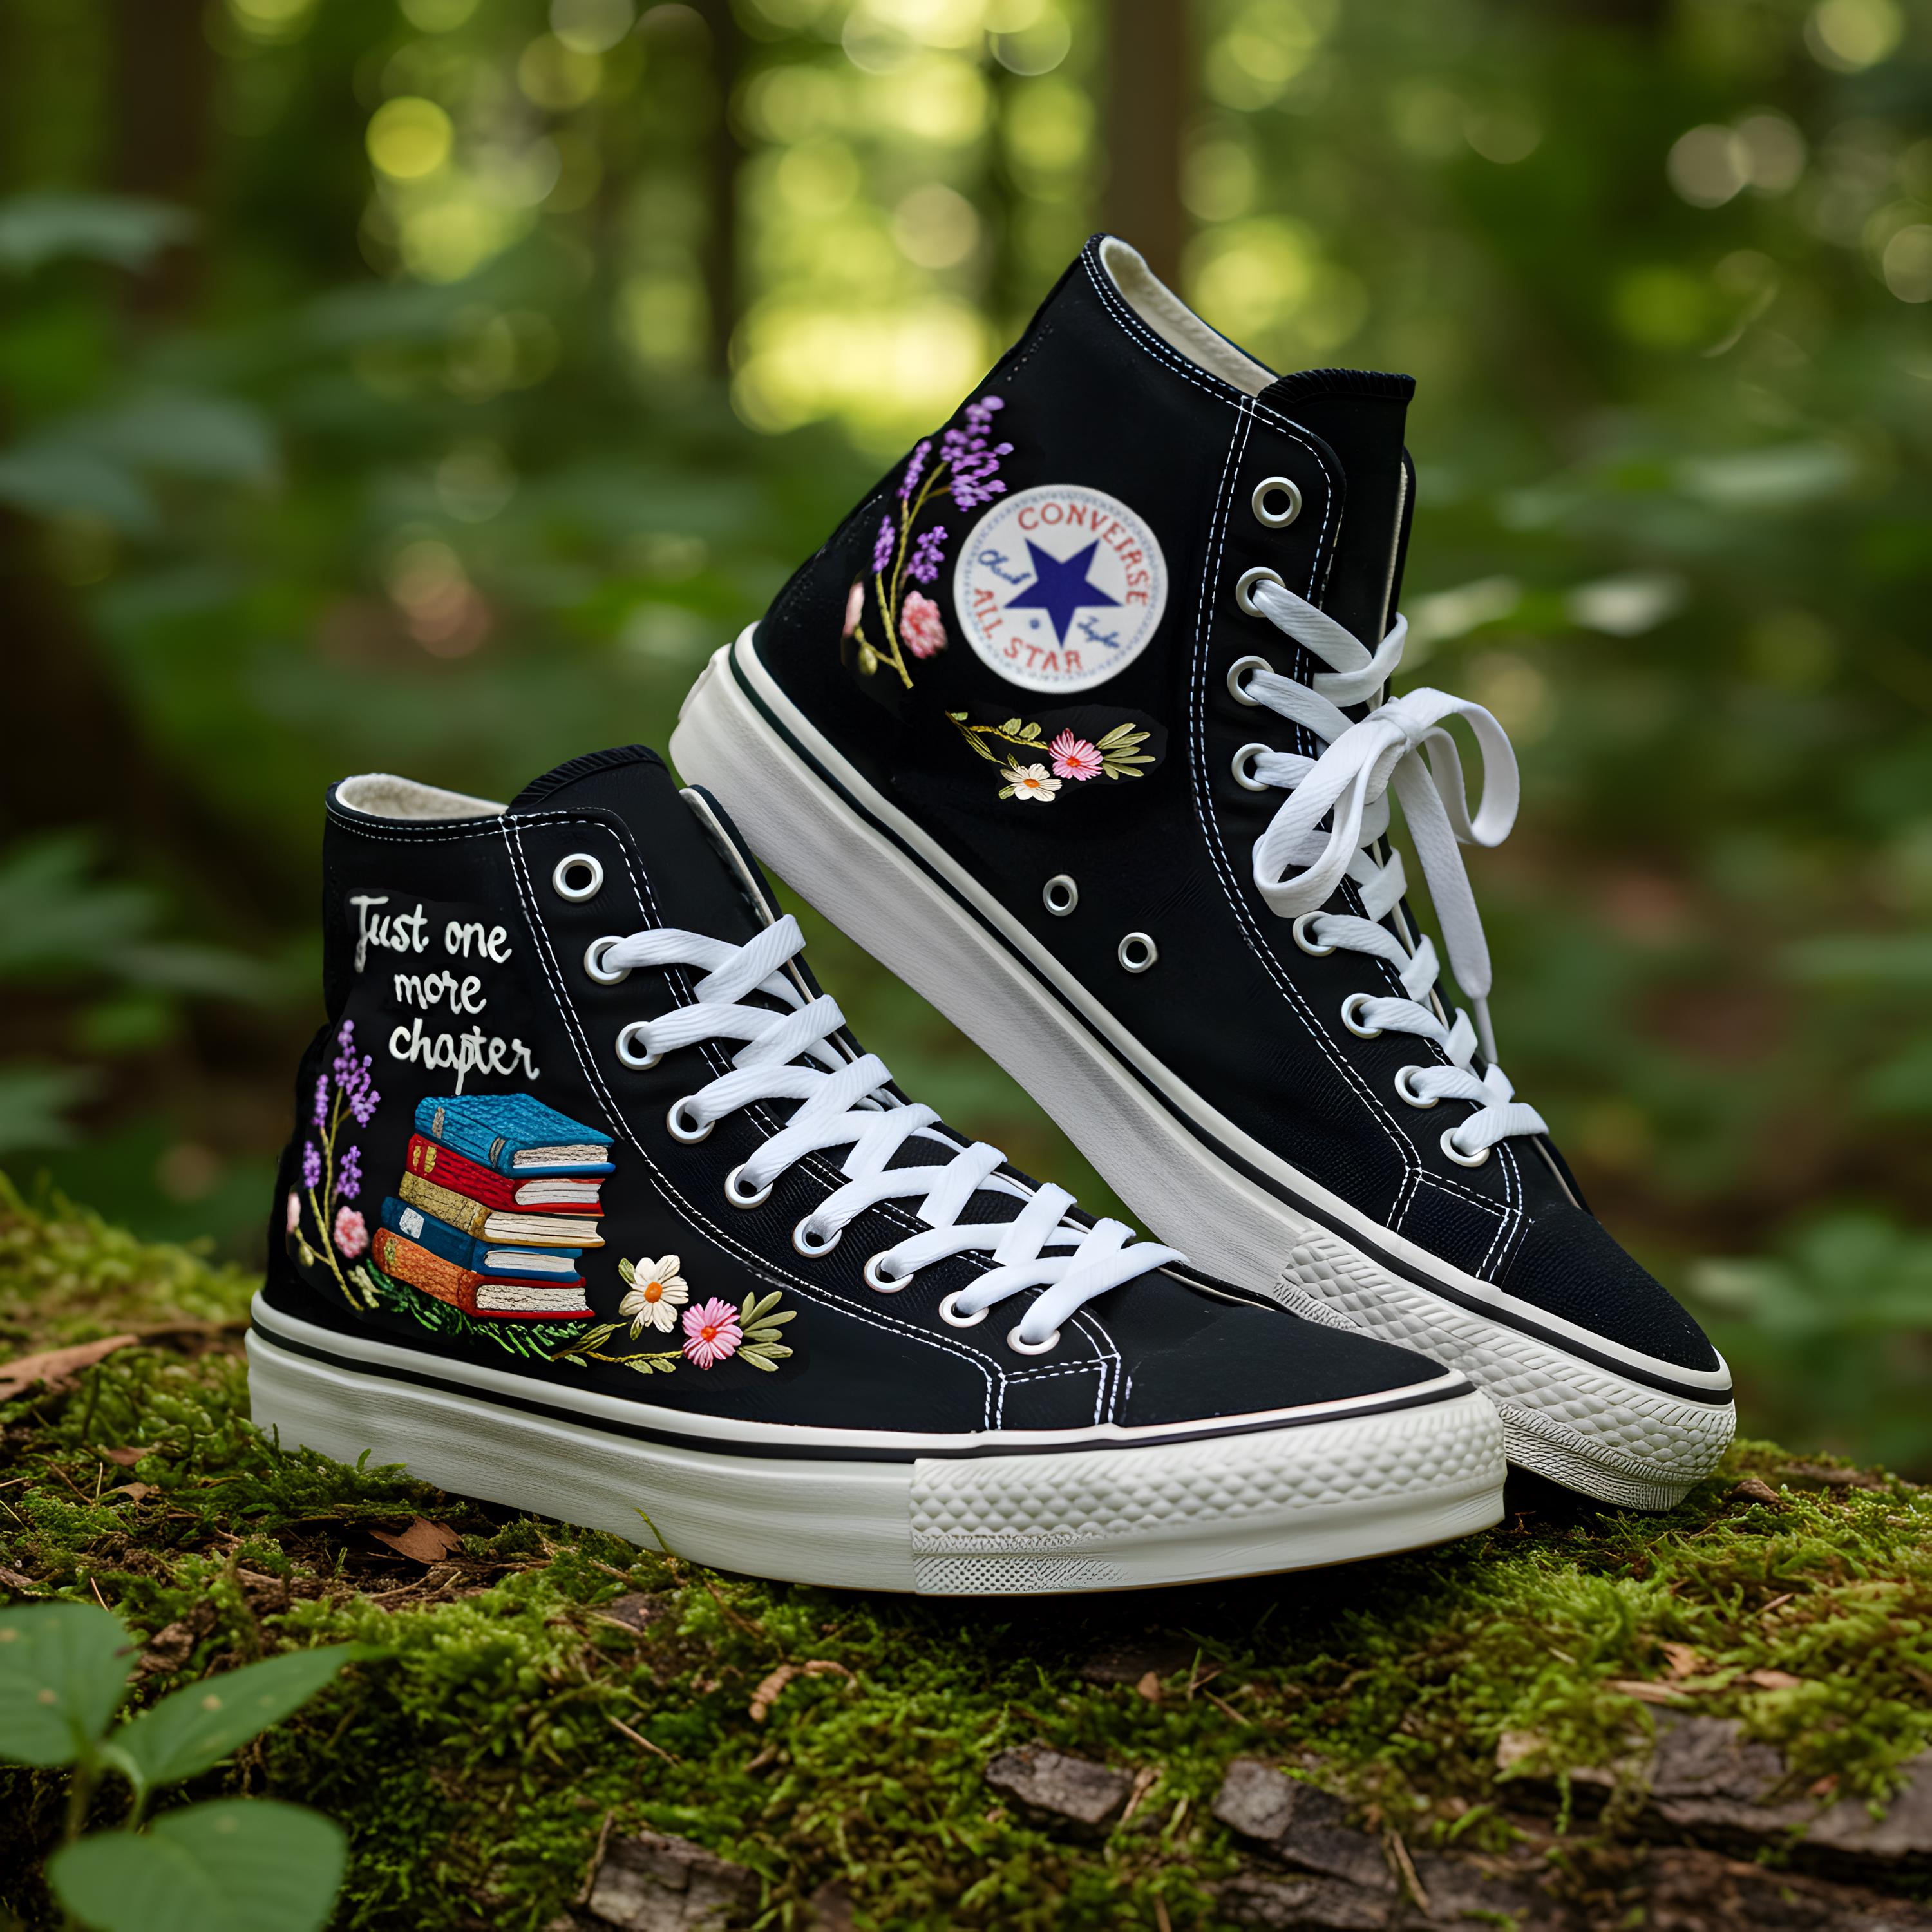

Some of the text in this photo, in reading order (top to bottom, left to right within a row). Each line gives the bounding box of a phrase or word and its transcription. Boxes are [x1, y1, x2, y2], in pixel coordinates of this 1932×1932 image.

[973, 587, 1083, 673] ALL STAR
[350, 895, 513, 974] Just one
[393, 970, 487, 1014] more
[388, 1018, 540, 1095] chapter
